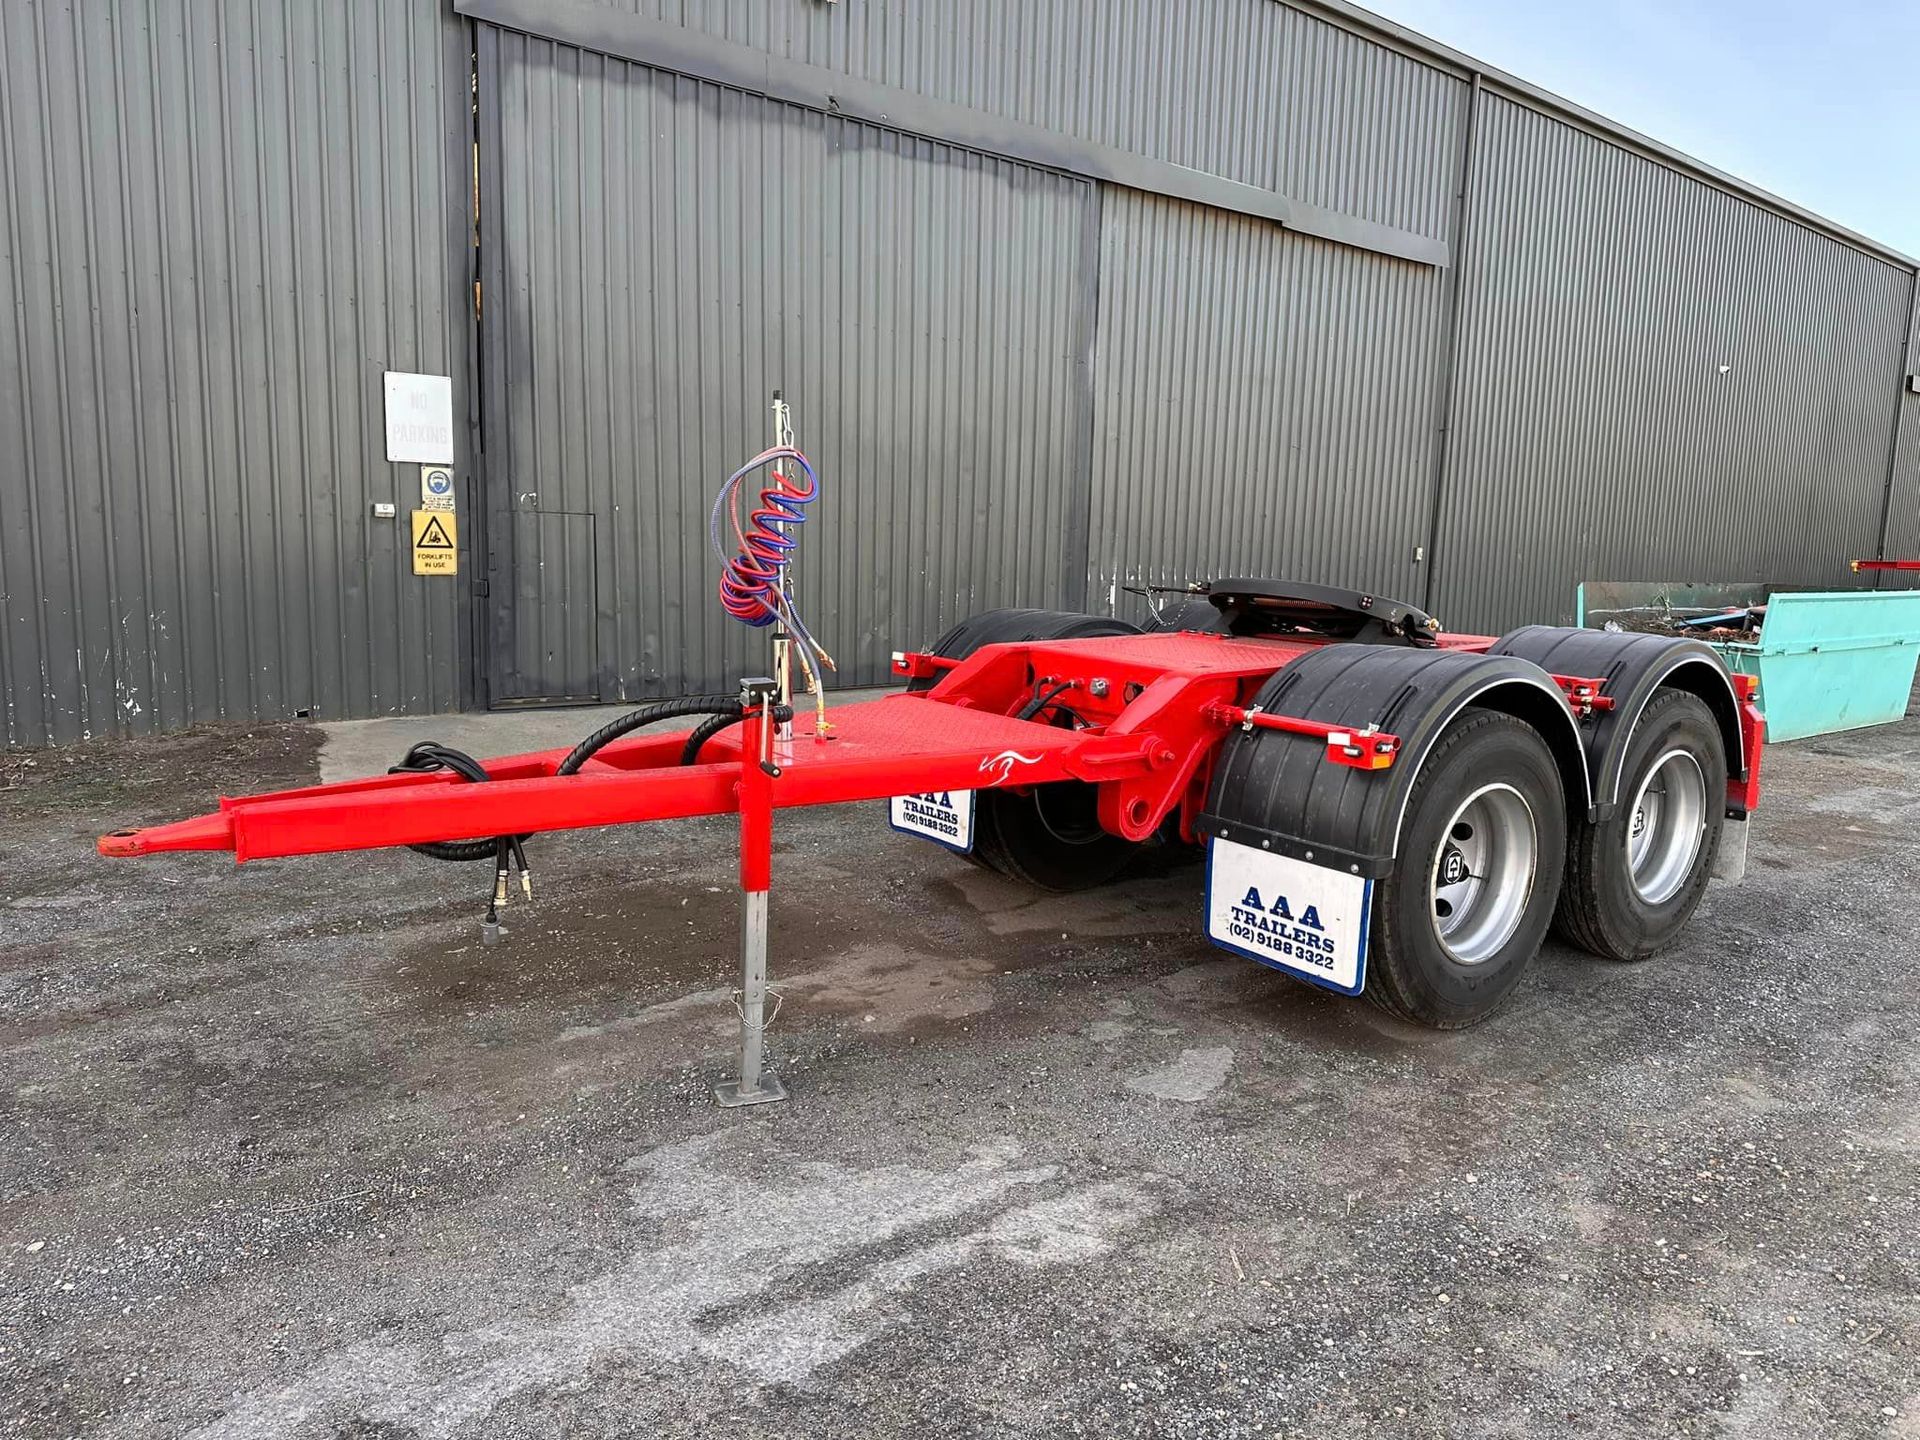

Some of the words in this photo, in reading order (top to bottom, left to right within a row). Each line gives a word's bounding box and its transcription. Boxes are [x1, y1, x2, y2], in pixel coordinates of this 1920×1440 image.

[410, 391, 428, 410] NO
[392, 423, 448, 444] PARKING
[903, 799, 958, 825] TRAILERS
[909, 791, 953, 809] AA
[902, 812, 918, 825] (02)
[919, 816, 938, 830] 9188
[938, 823, 958, 837] 3322
[1231, 906, 1335, 954] TRAILERS
[1229, 922, 1255, 943] (02)
[1256, 932, 1293, 955] 9188
[1295, 946, 1335, 970] 3322
